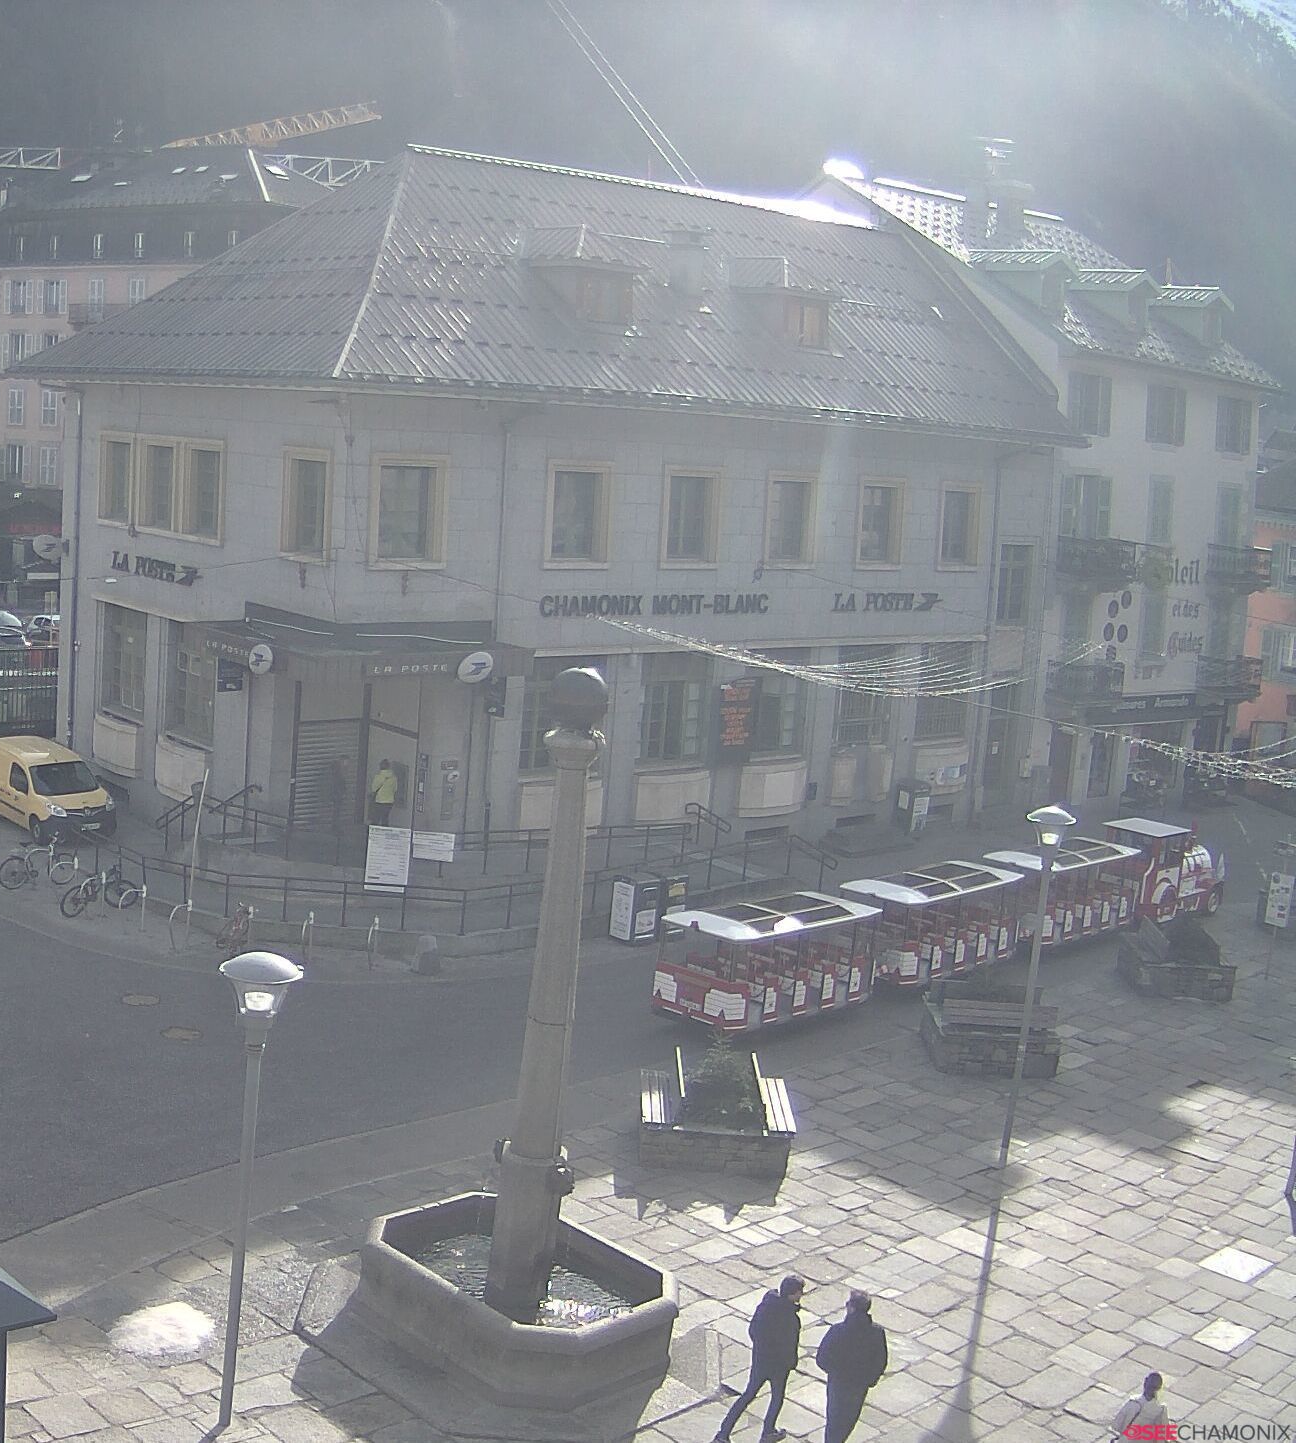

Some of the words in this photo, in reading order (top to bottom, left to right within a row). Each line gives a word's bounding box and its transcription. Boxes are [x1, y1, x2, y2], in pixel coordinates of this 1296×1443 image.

[111, 550, 130, 573] LA
[134, 556, 176, 583] POSTE
[1167, 557, 1200, 585] oleil
[538, 594, 643, 617] CHAMONIX
[652, 594, 770, 615] MONT-BLANC
[831, 592, 857, 612] LA
[862, 592, 915, 612] POSTE
[374, 665, 392, 674] LA
[401, 664, 448, 673] POSTE
